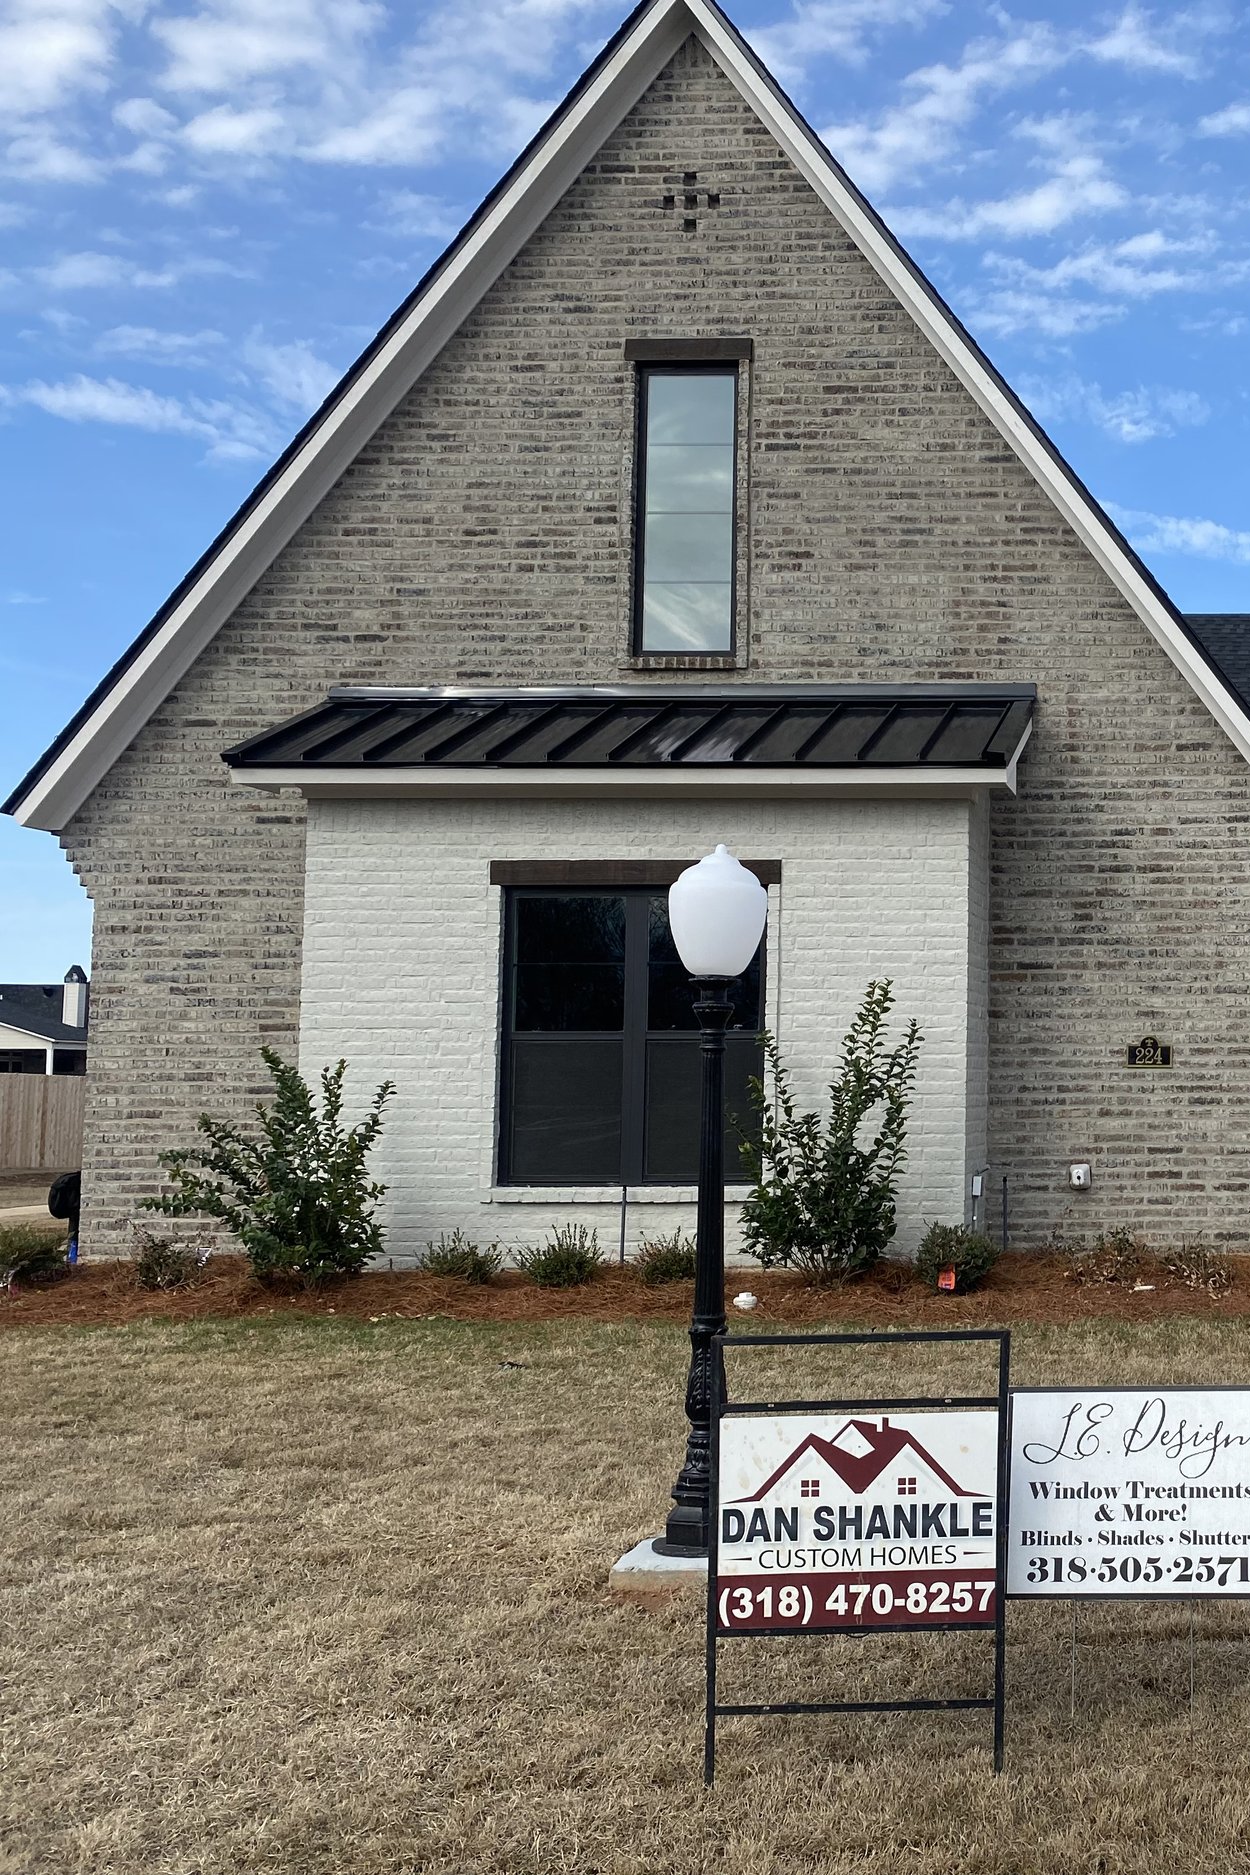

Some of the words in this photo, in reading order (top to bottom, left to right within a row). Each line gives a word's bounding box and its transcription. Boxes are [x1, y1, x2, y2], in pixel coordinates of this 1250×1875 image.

[1135, 1047, 1163, 1065] 224
[1028, 1480, 1121, 1500] Window
[1093, 1503, 1116, 1522] &
[1122, 1502, 1188, 1522] More!
[721, 1506, 799, 1544] DAN
[812, 1501, 994, 1542] SHANKLE
[1020, 1530, 1083, 1546] Blinds
[1097, 1529, 1164, 1546] Shades
[758, 1547, 862, 1569] CUSTOM
[870, 1544, 958, 1567] HOMES
[718, 1584, 813, 1628] (318)
[825, 1580, 996, 1616] 470-8257
